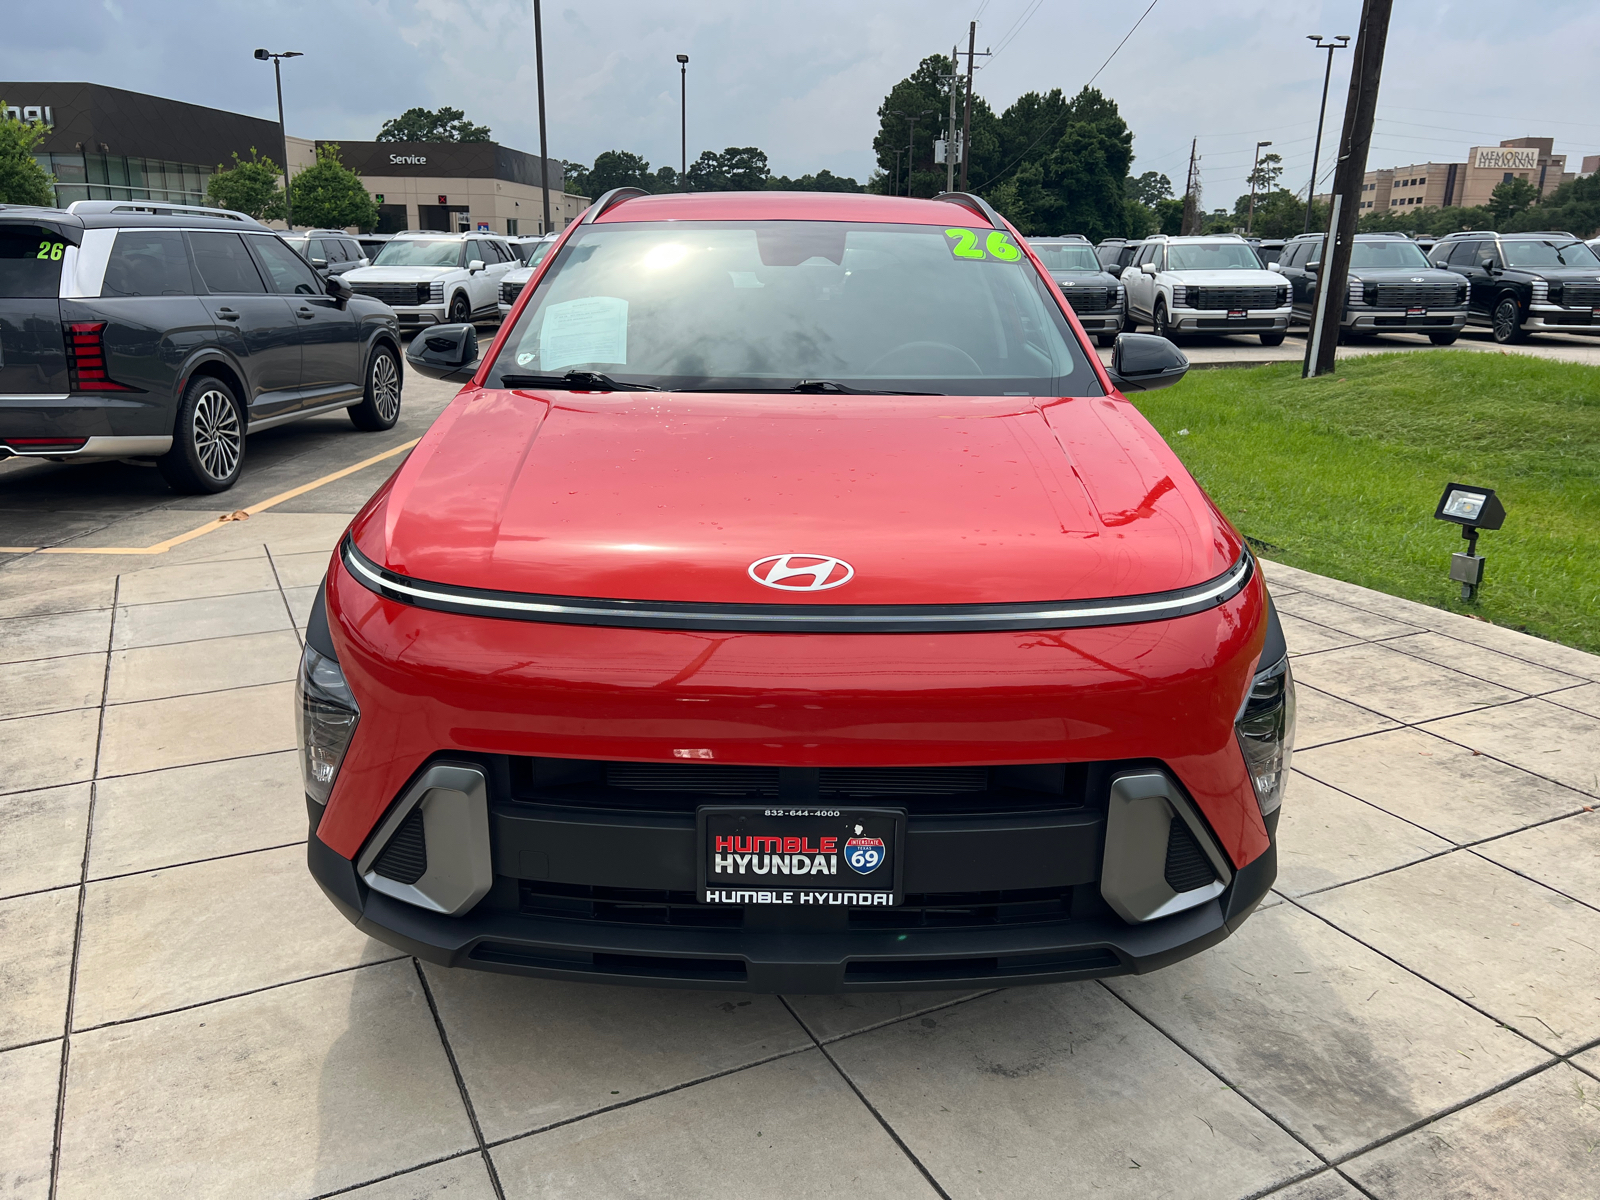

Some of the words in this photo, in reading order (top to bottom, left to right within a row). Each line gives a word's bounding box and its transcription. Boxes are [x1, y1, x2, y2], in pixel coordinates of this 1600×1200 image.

[389, 154, 427, 165] Service
[1478, 158, 1535, 167] HERMANN
[1480, 151, 1536, 161] MEMORIAL
[37, 241, 63, 260] 26
[944, 228, 1021, 262] 26
[764, 809, 840, 817] 832-644-4000
[715, 835, 838, 853] HUMBLE
[714, 853, 838, 875] HYUNDAI
[850, 850, 879, 867] 69
[706, 890, 794, 904] HUMBLE
[799, 892, 894, 906] HYUNDAI
